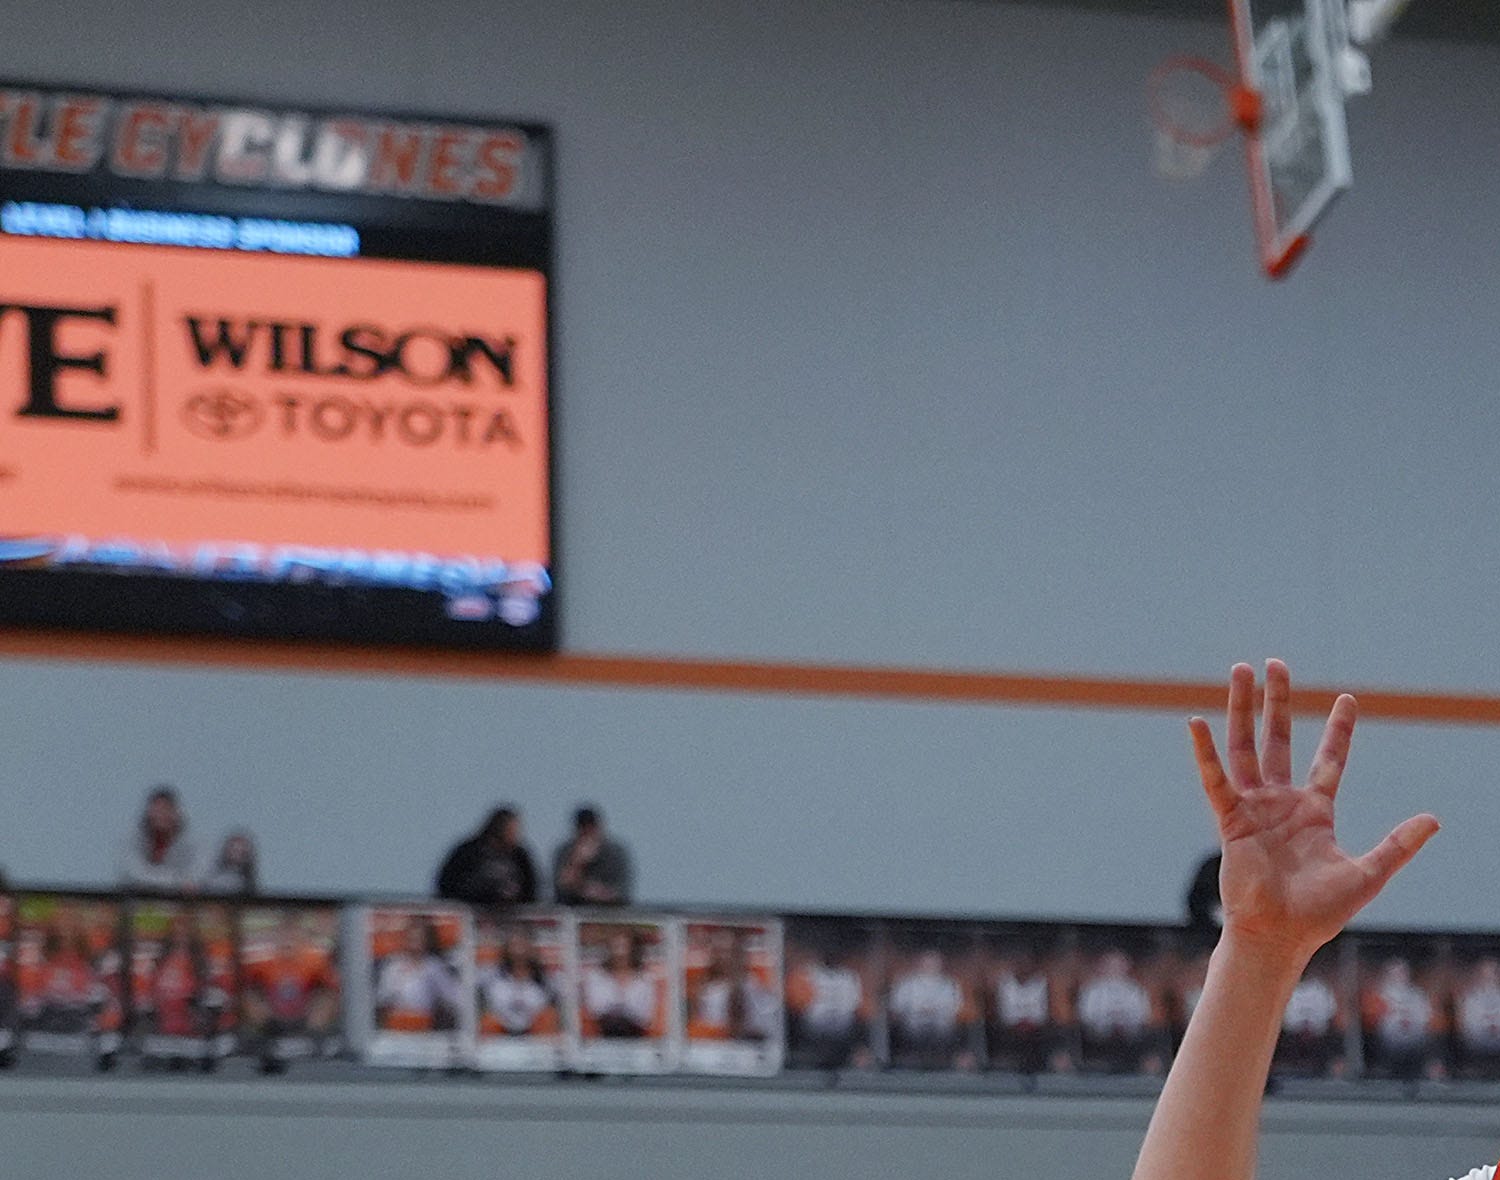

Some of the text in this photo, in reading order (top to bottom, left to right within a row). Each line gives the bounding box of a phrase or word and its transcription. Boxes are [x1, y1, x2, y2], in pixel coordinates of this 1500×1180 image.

[0, 92, 101, 170] LE
[0, 303, 121, 424] E
[184, 314, 518, 389] WILSON
[273, 392, 526, 448] TOYOTA
